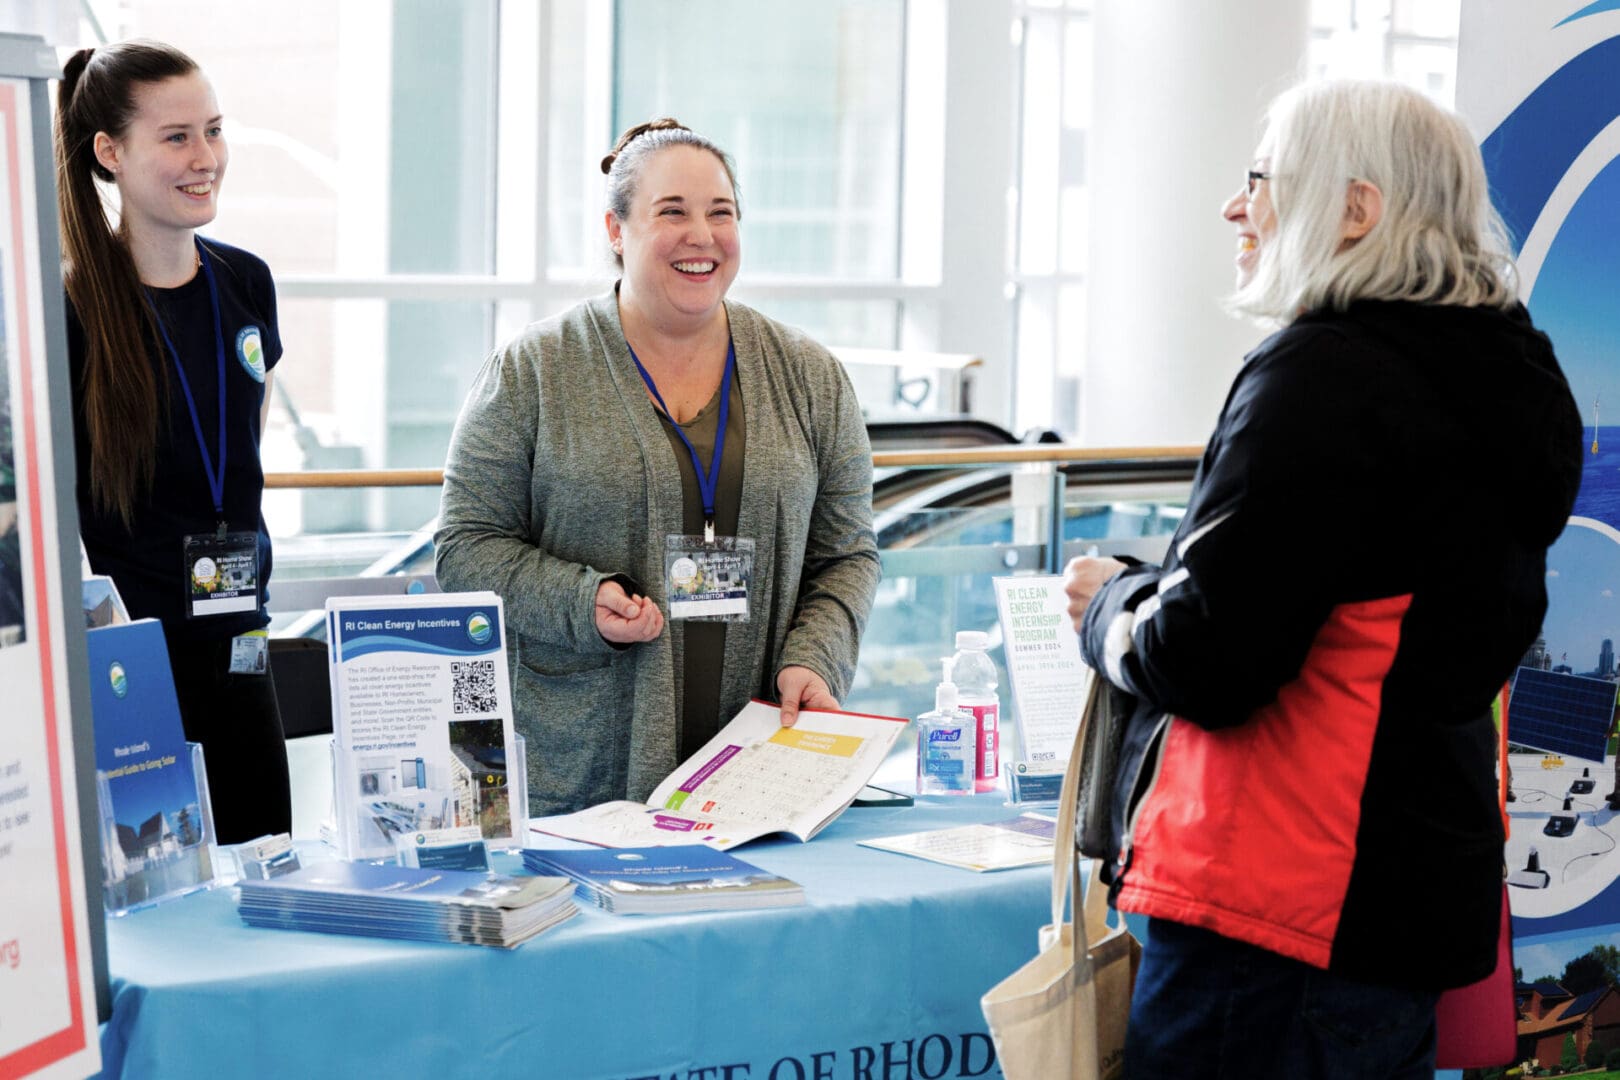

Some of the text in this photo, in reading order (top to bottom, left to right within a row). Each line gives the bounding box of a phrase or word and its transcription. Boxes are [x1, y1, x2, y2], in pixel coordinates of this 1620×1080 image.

[210, 591, 239, 599] EXHIBITOR
[691, 592, 725, 601] EXHIBITOR
[1007, 586, 1048, 600] RI CLEAN
[1010, 601, 1044, 614] ENERGY
[345, 618, 460, 631] RI Clean Energy Incentives
[1011, 614, 1062, 628] INTERNSHIP
[1014, 628, 1058, 642] PROGRAM
[1014, 644, 1041, 652] SUMMER
[932, 730, 958, 740] Purell
[768, 1051, 836, 1080] OF
[849, 1032, 1003, 1080] RHOD
